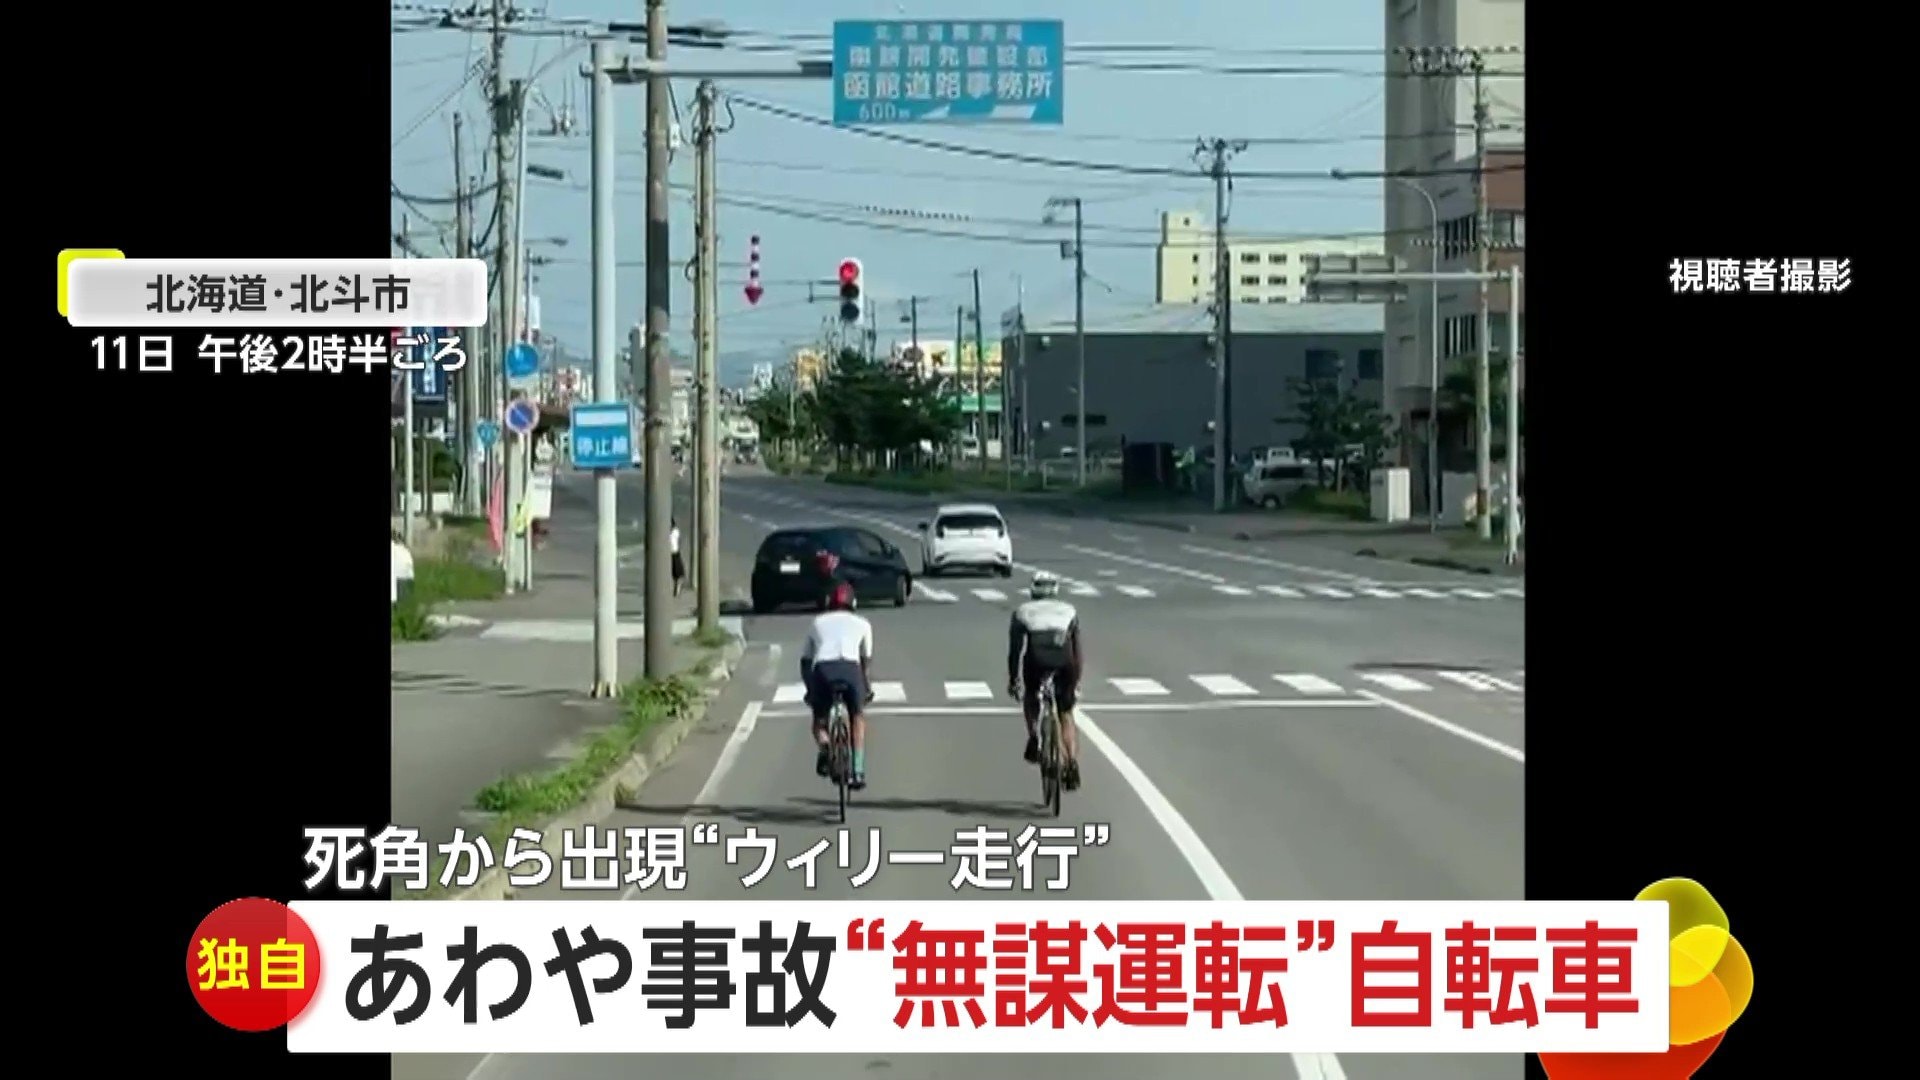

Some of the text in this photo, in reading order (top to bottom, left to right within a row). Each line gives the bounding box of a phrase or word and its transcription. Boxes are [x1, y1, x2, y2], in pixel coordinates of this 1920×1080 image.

[843, 71, 1052, 99] 函館道路事務所
[576, 435, 629, 457] 停止線
